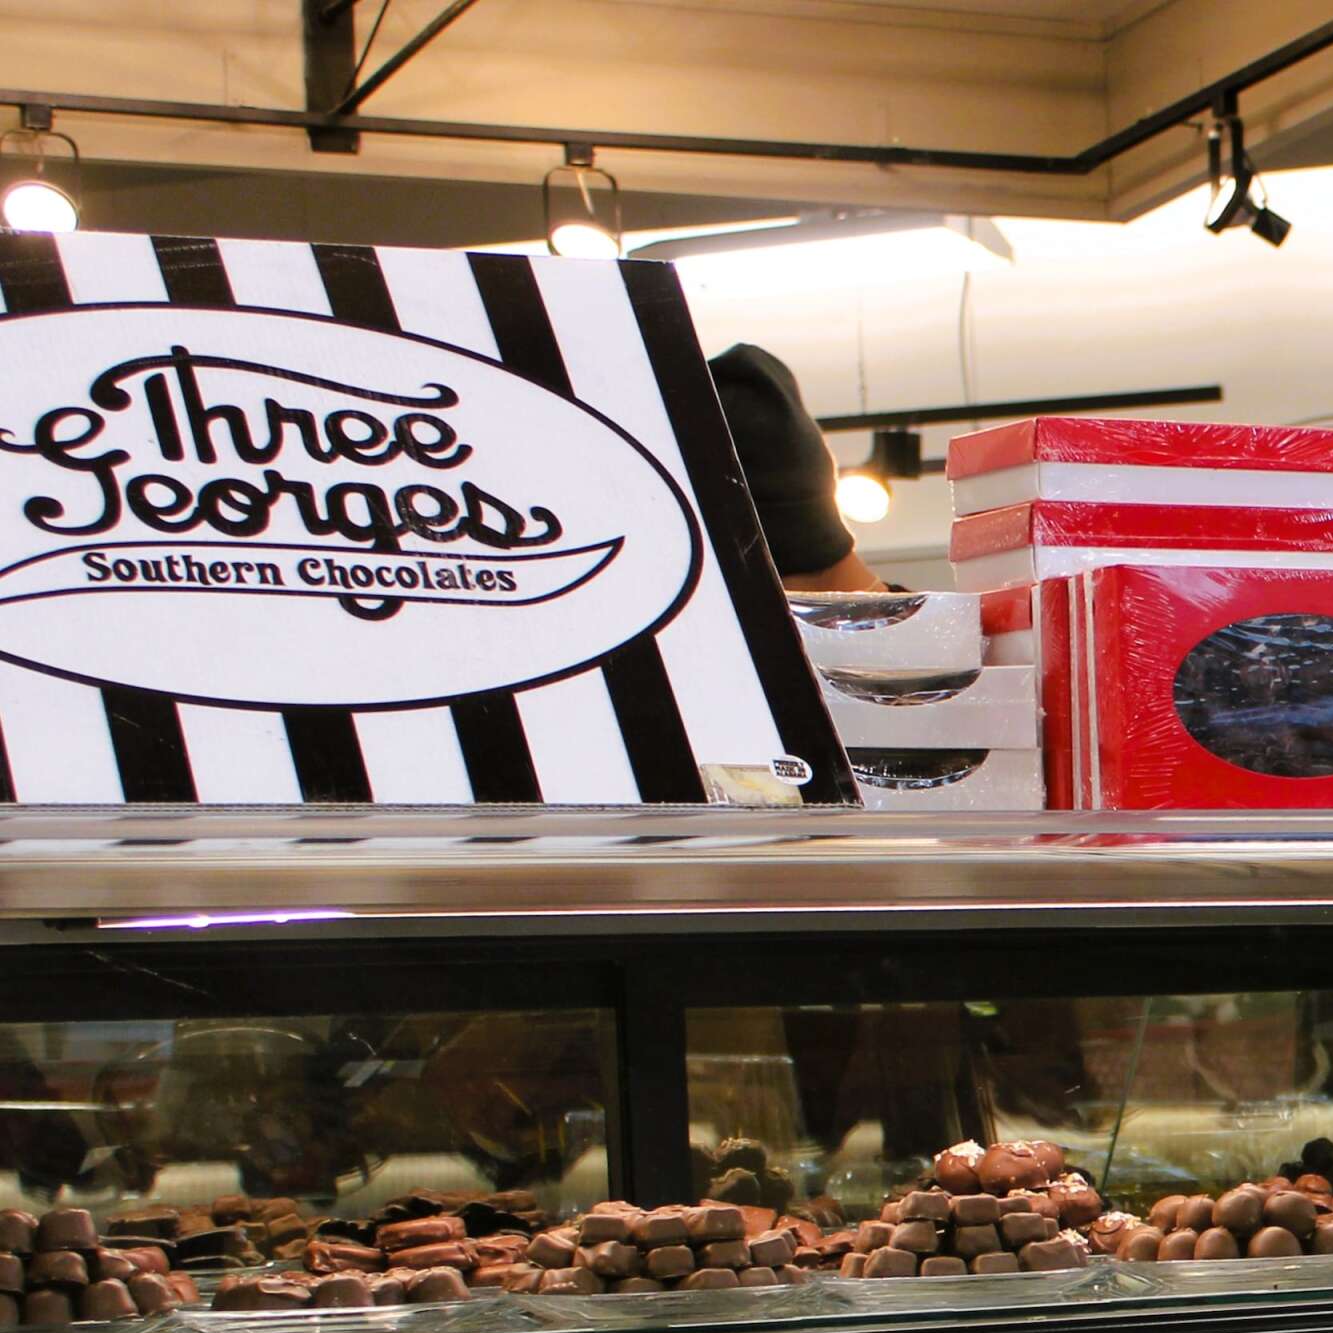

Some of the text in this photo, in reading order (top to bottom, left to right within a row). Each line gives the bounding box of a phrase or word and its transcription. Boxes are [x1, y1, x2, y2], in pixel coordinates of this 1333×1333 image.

[90, 345, 472, 470] Three
[14, 407, 562, 580] Georges
[81, 552, 518, 592] Southern Chocolates
